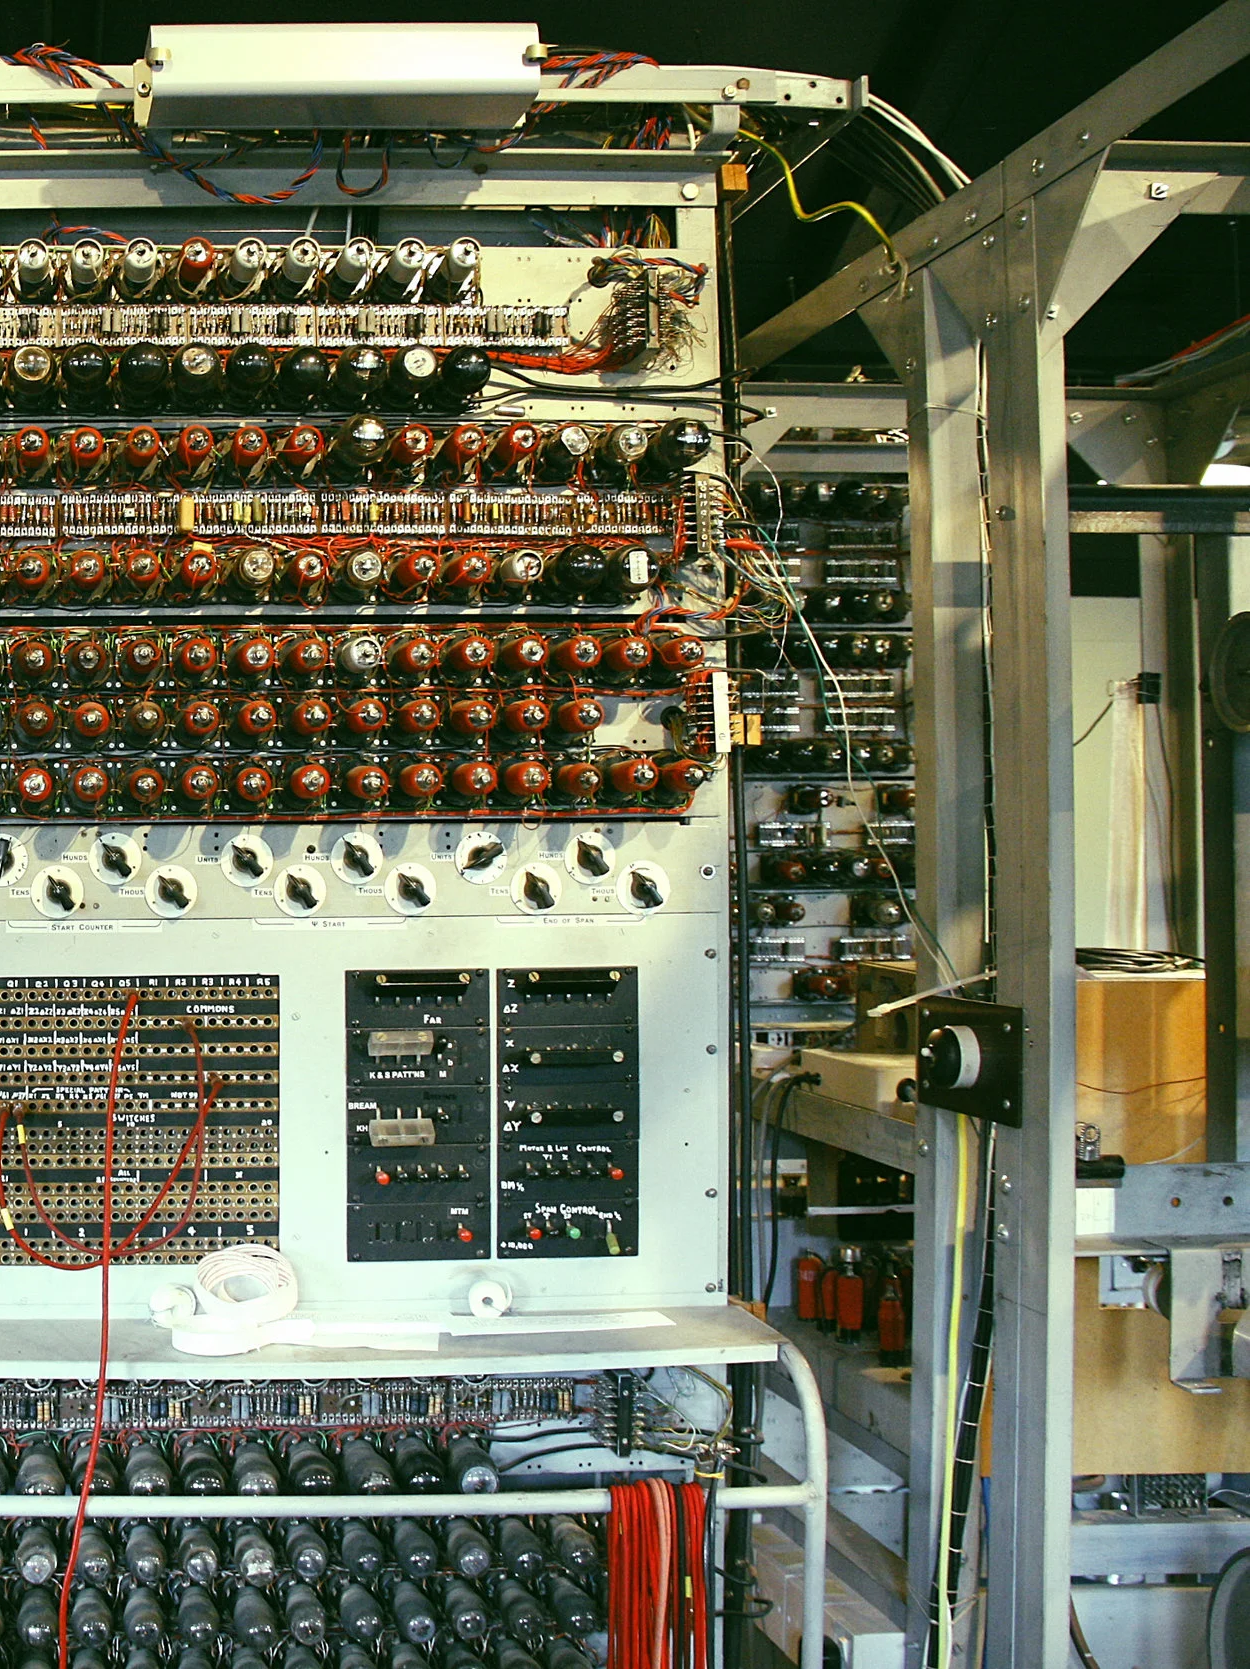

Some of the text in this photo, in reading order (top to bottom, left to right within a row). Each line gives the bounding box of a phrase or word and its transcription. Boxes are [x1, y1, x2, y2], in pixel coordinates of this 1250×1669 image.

[305, 853, 330, 861] HUNDS
[431, 852, 453, 860] UNITS
[592, 886, 614, 894] THOUS
[119, 979, 130, 987] Q5
[202, 978, 213, 986] R3
[257, 978, 270, 986] R5
[507, 979, 515, 988] Z
[186, 1005, 234, 1013] COMMONS
[424, 1014, 441, 1024] FAR
[348, 1102, 377, 1110] BREAM
[113, 1113, 155, 1123] SWITCHES
[576, 1144, 611, 1152] CONTROL
[535, 1203, 599, 1216] SPAN CONTROL
[79, 1228, 85, 1237] 2
[188, 1226, 196, 1236] 4
[246, 1225, 254, 1235] 5
